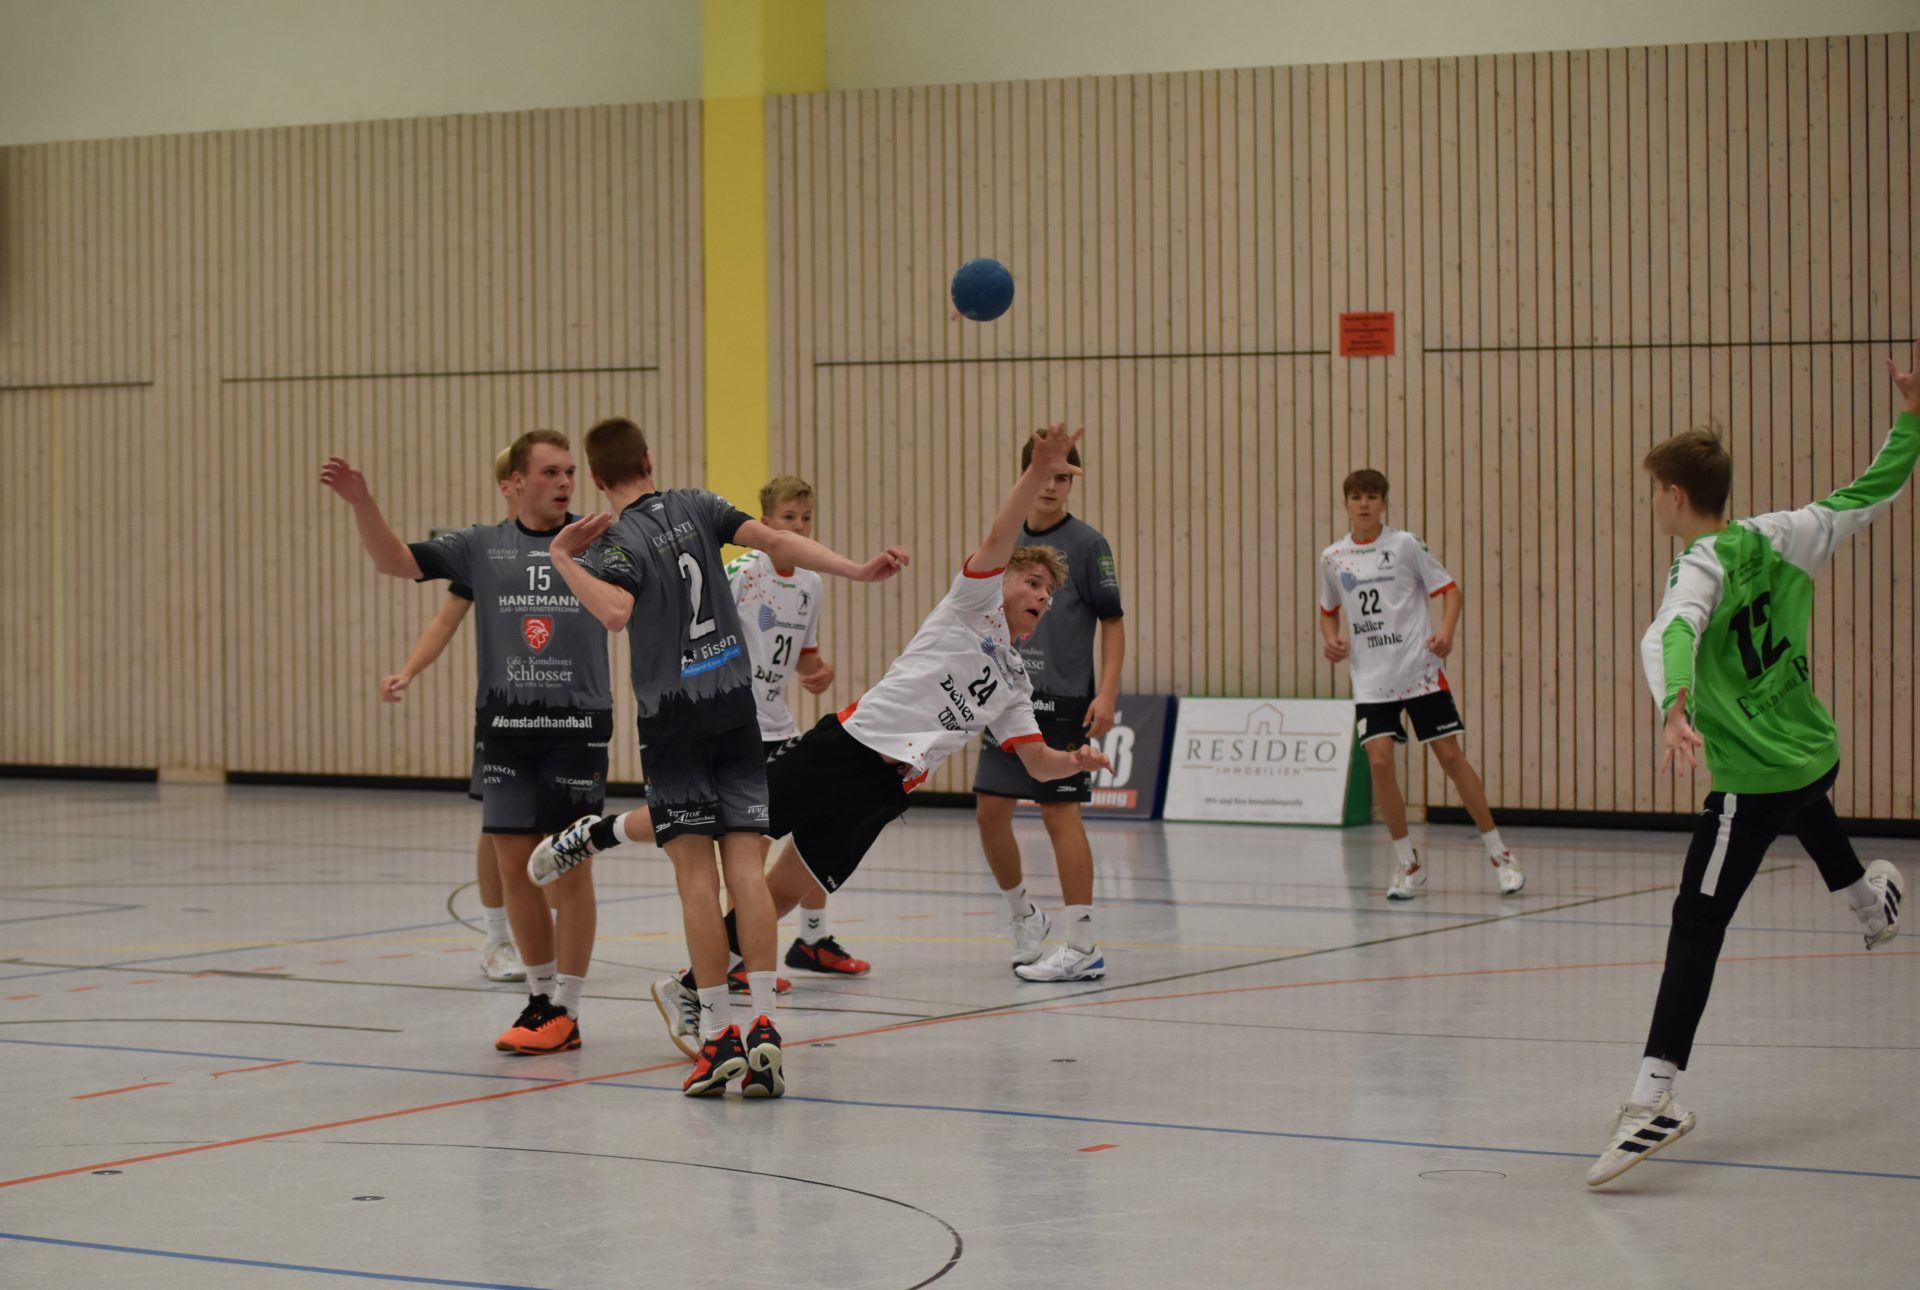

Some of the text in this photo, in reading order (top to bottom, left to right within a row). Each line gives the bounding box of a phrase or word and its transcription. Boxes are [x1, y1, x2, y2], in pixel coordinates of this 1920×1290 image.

[526, 565, 551, 591] 15
[498, 595, 579, 606] HANEMANN
[678, 552, 717, 641] 2
[1359, 588, 1382, 616] 22
[1728, 591, 1792, 680] 12
[772, 634, 792, 666] 21
[507, 665, 573, 682] Schlosser
[968, 665, 998, 707] 24
[492, 715, 592, 728] #domstadthandball
[1187, 738, 1337, 763] RESIDEO
[1216, 766, 1300, 776] IMMOBILIEN
